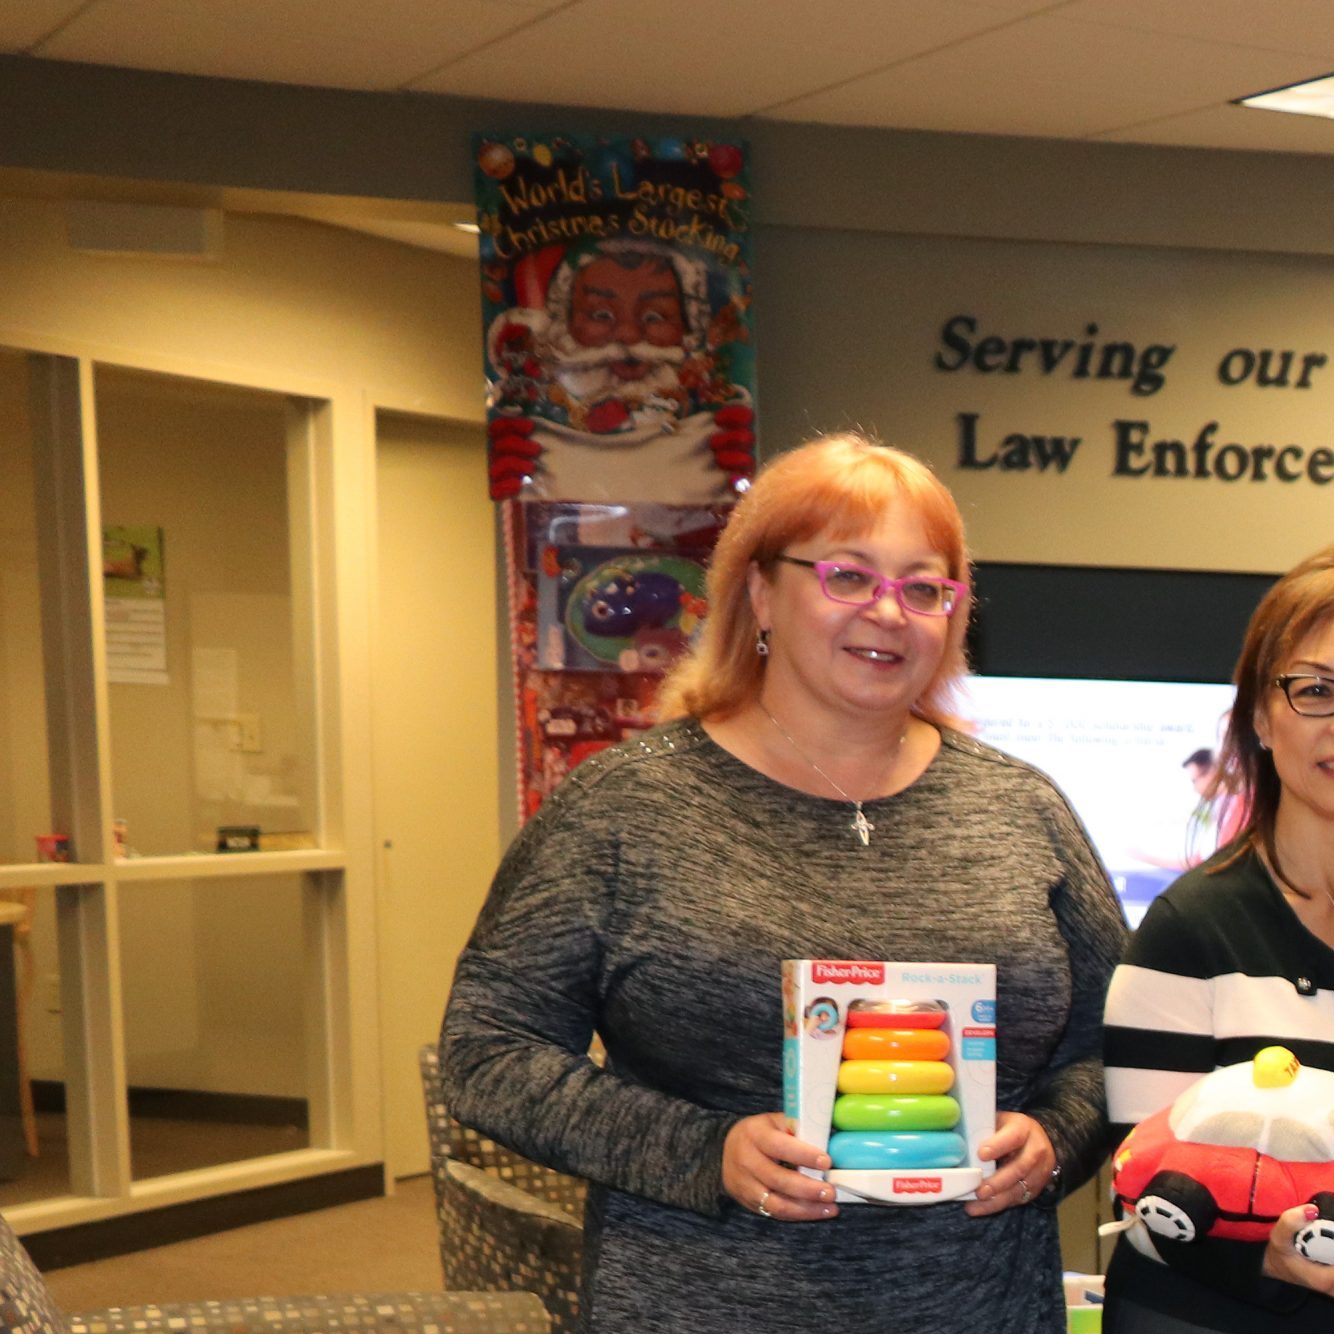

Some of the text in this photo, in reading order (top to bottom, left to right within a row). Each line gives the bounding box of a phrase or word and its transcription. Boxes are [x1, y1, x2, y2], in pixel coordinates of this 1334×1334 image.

[494, 203, 741, 261] Christmas Stocking
[933, 314, 1176, 395] Serving
[1216, 336, 1328, 391] our
[957, 412, 1081, 475] Law
[815, 965, 881, 979] Fisher-Price
[901, 972, 982, 985] Rock-a-Stack
